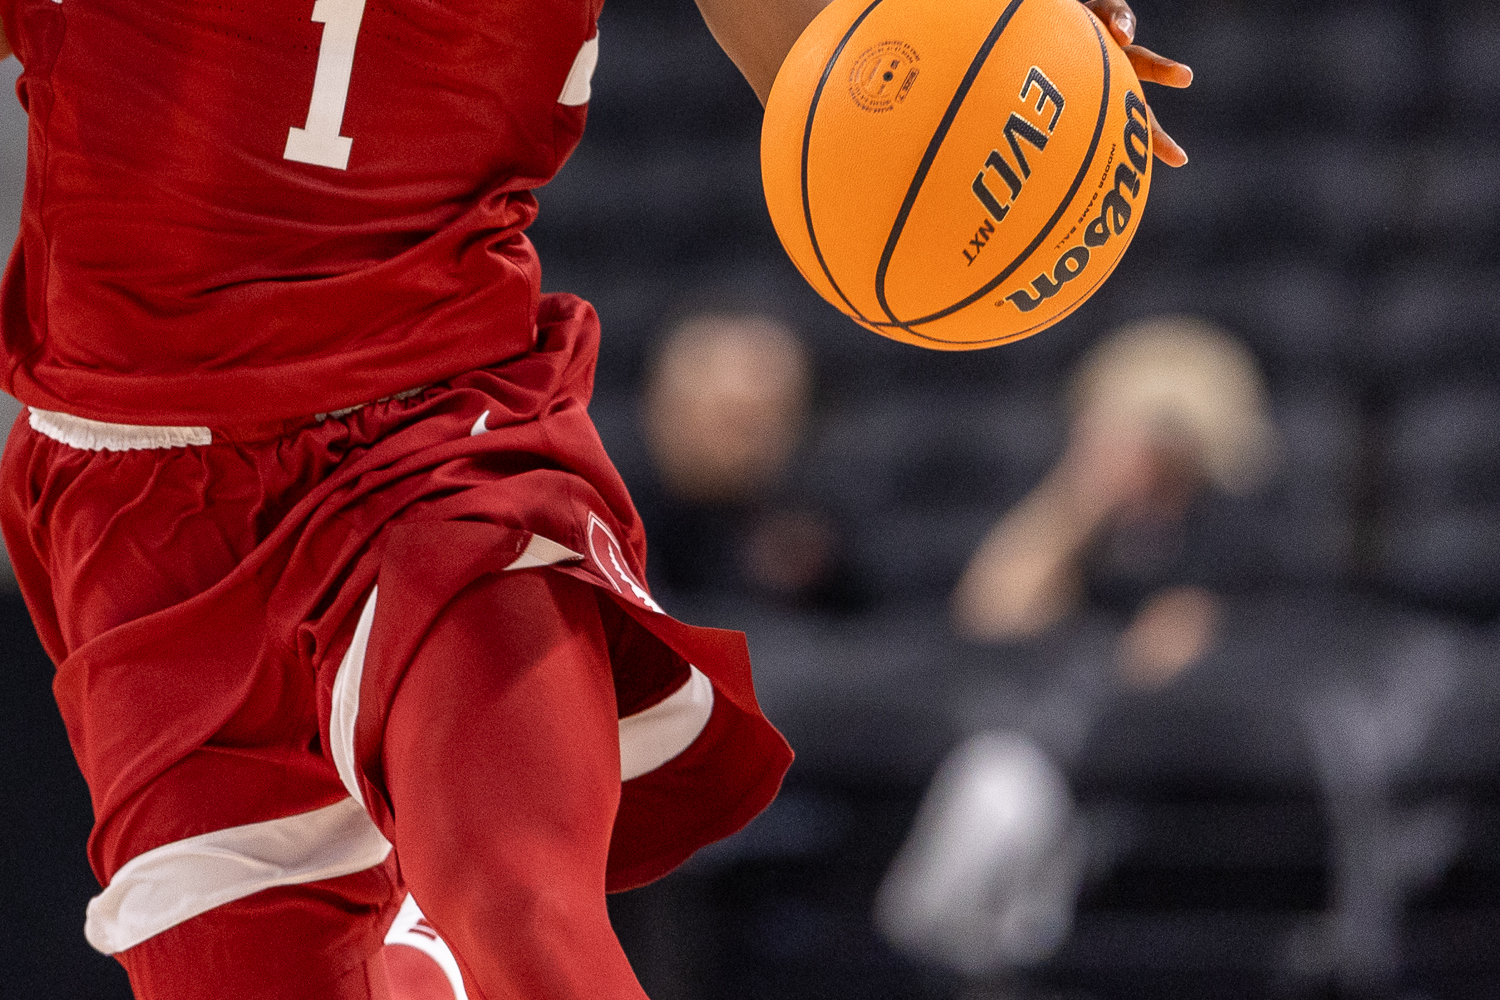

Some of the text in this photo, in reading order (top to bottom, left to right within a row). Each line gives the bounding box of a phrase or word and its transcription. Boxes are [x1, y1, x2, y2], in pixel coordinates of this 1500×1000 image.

[961, 65, 1065, 267] EVO NXT
[1053, 143, 1116, 250] INDOOR GAME BALL
